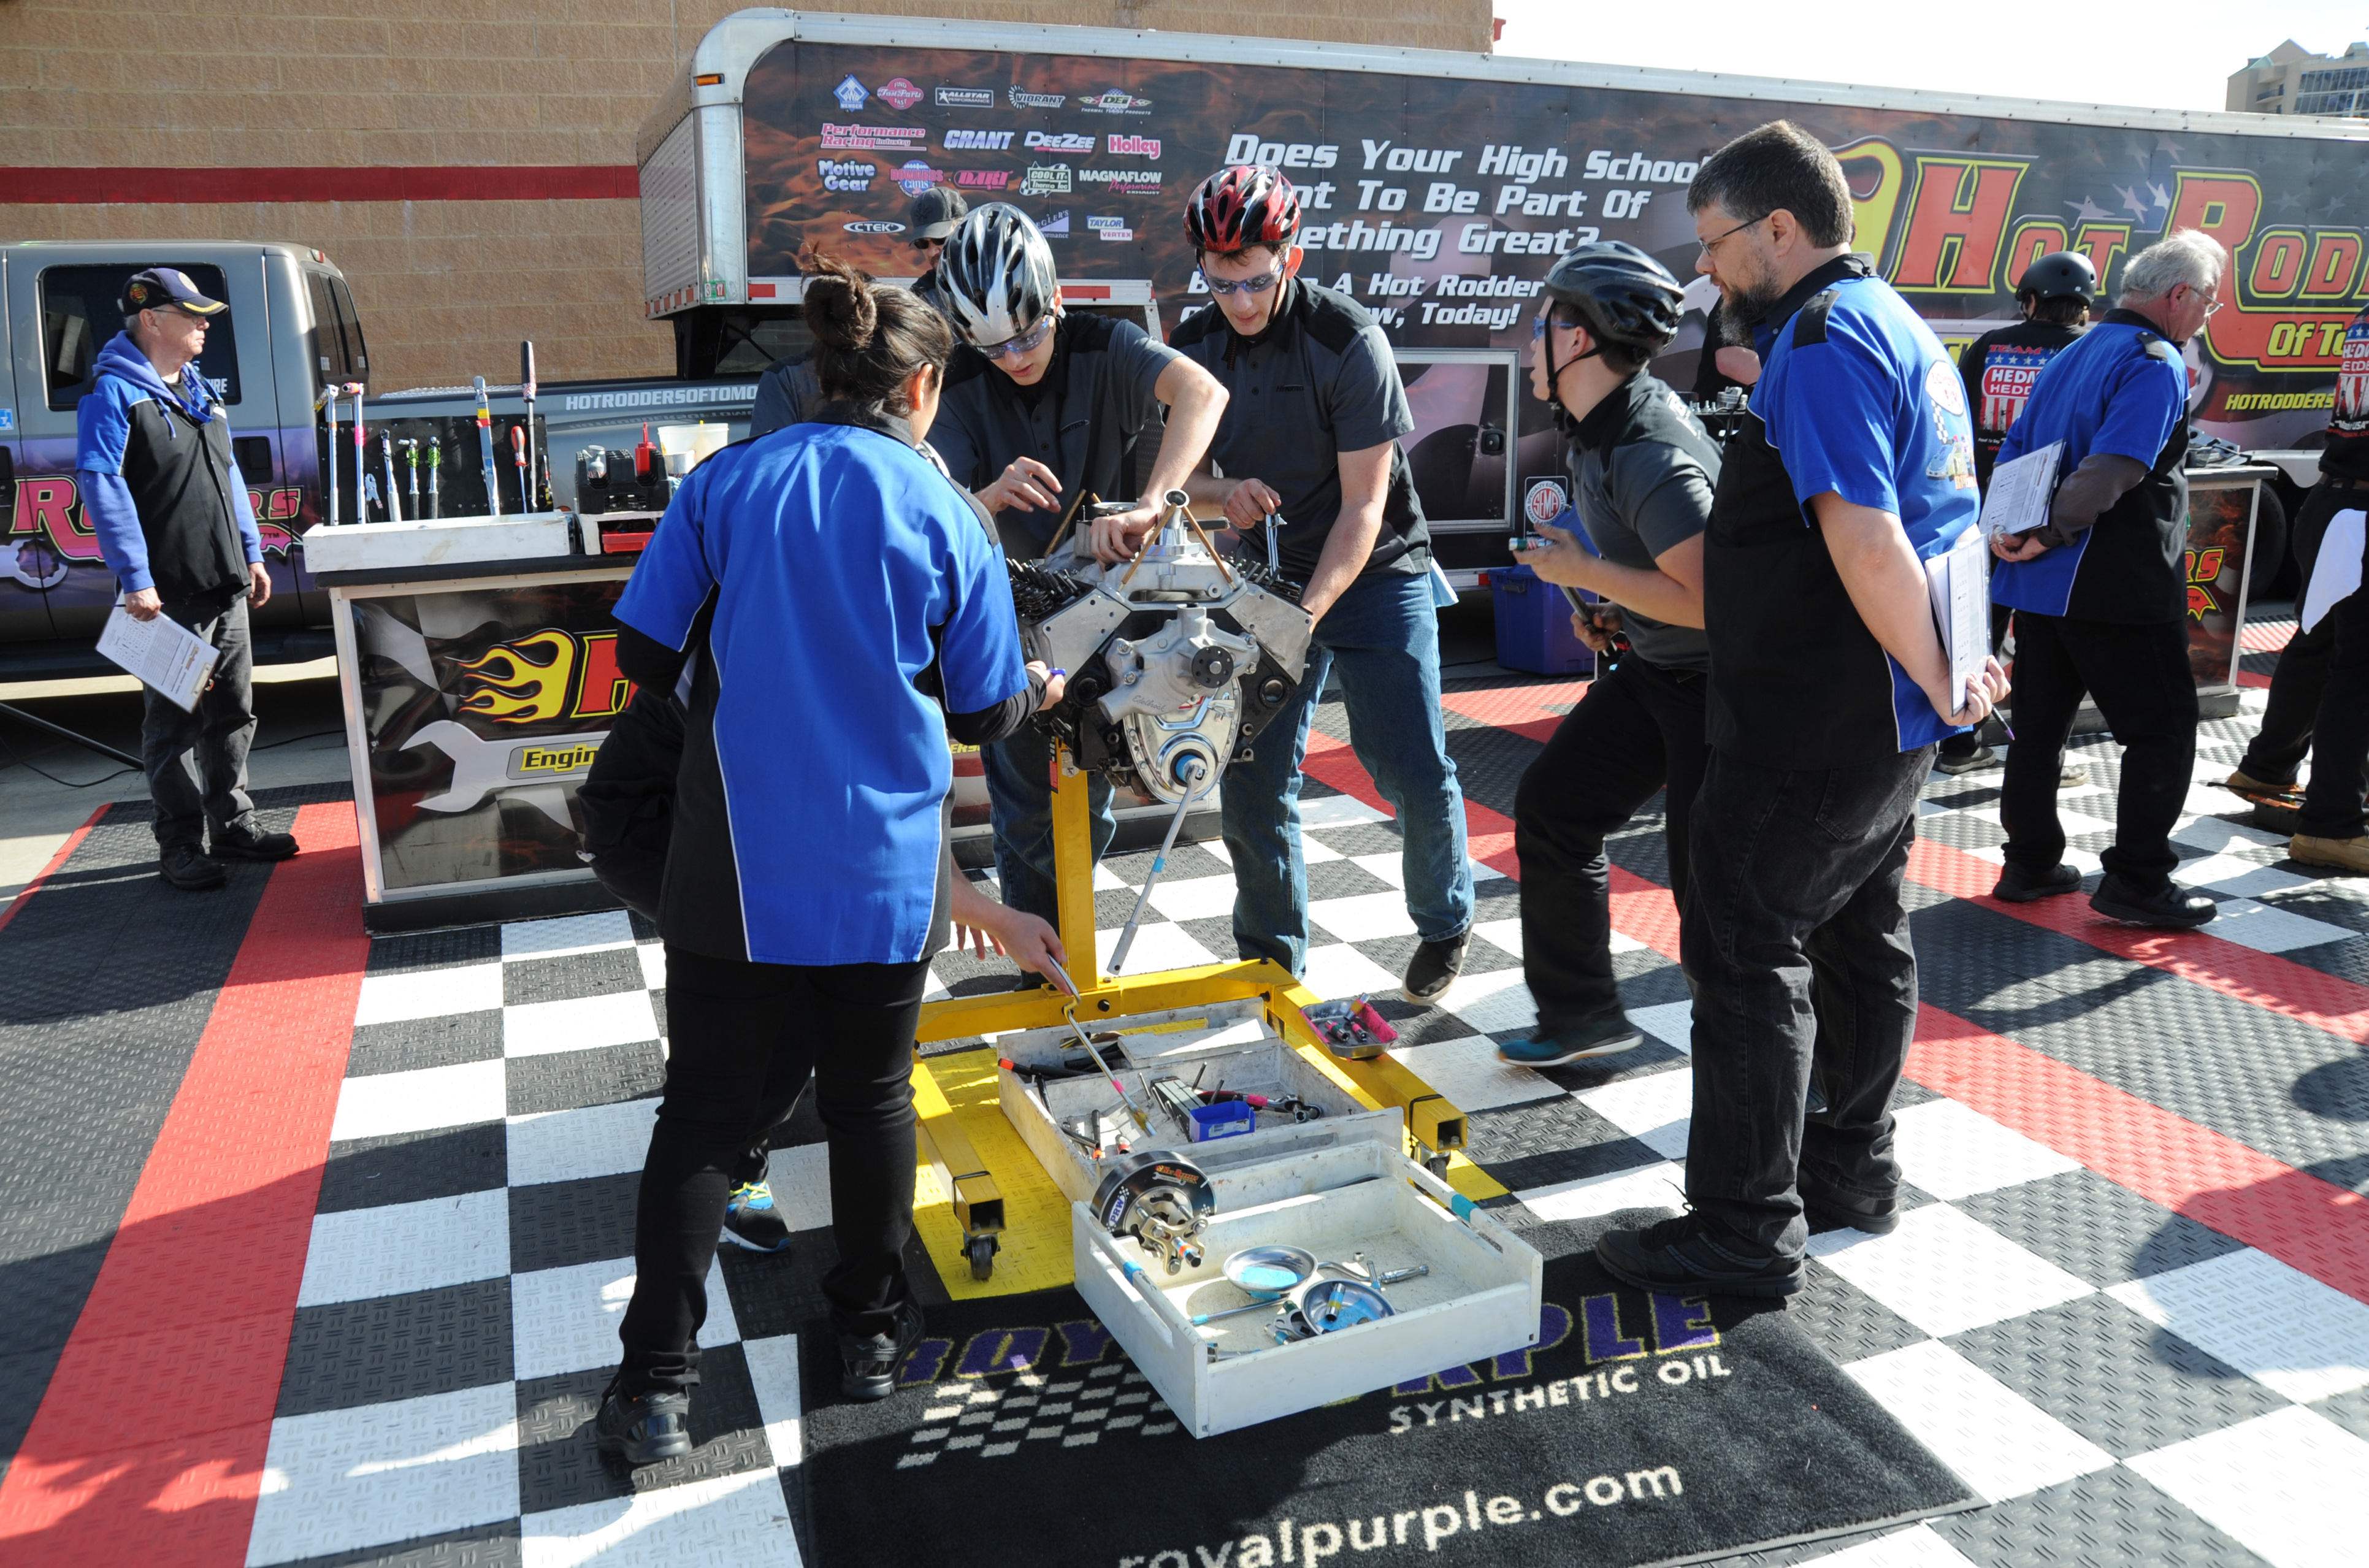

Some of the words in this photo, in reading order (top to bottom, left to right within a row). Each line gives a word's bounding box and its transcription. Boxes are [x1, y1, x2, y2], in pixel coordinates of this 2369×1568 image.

[1016, 93, 1066, 105] VIBRANT
[821, 123, 926, 137] Performance
[944, 130, 1015, 150] GRANT
[822, 134, 876, 148] Racing
[875, 138, 911, 147] Industry
[1109, 134, 1161, 159] Holley
[818, 160, 876, 177] Motive
[1225, 134, 1339, 167] Does
[1361, 140, 1463, 174] Your
[1477, 145, 1568, 184] High
[824, 174, 870, 191] Gear
[890, 168, 944, 182] HOWARDS
[1031, 170, 1055, 180] COOL
[1079, 170, 1162, 183] MAGNAFLOW
[1358, 180, 1408, 212] To
[1423, 182, 1480, 213] Be
[1495, 185, 1588, 217] Part
[1602, 189, 1652, 219] Of
[854, 223, 890, 232] CTEK
[1089, 218, 1122, 228] TAYLOR
[1458, 223, 1600, 255] Great?
[1368, 273, 1425, 296] Hot
[1437, 275, 1545, 298] Rodder
[1420, 302, 1521, 330] Today!
[1989, 344, 2043, 354] TEAM
[2267, 323, 2317, 356] Of
[1533, 489, 1558, 519] SEMA
[1109, 1198, 1124, 1223] PRW
[1390, 1366, 1639, 1434] SYNTHETIC
[1657, 1355, 1733, 1385] OIL
[1118, 1465, 1685, 1568] royalpurple.com
